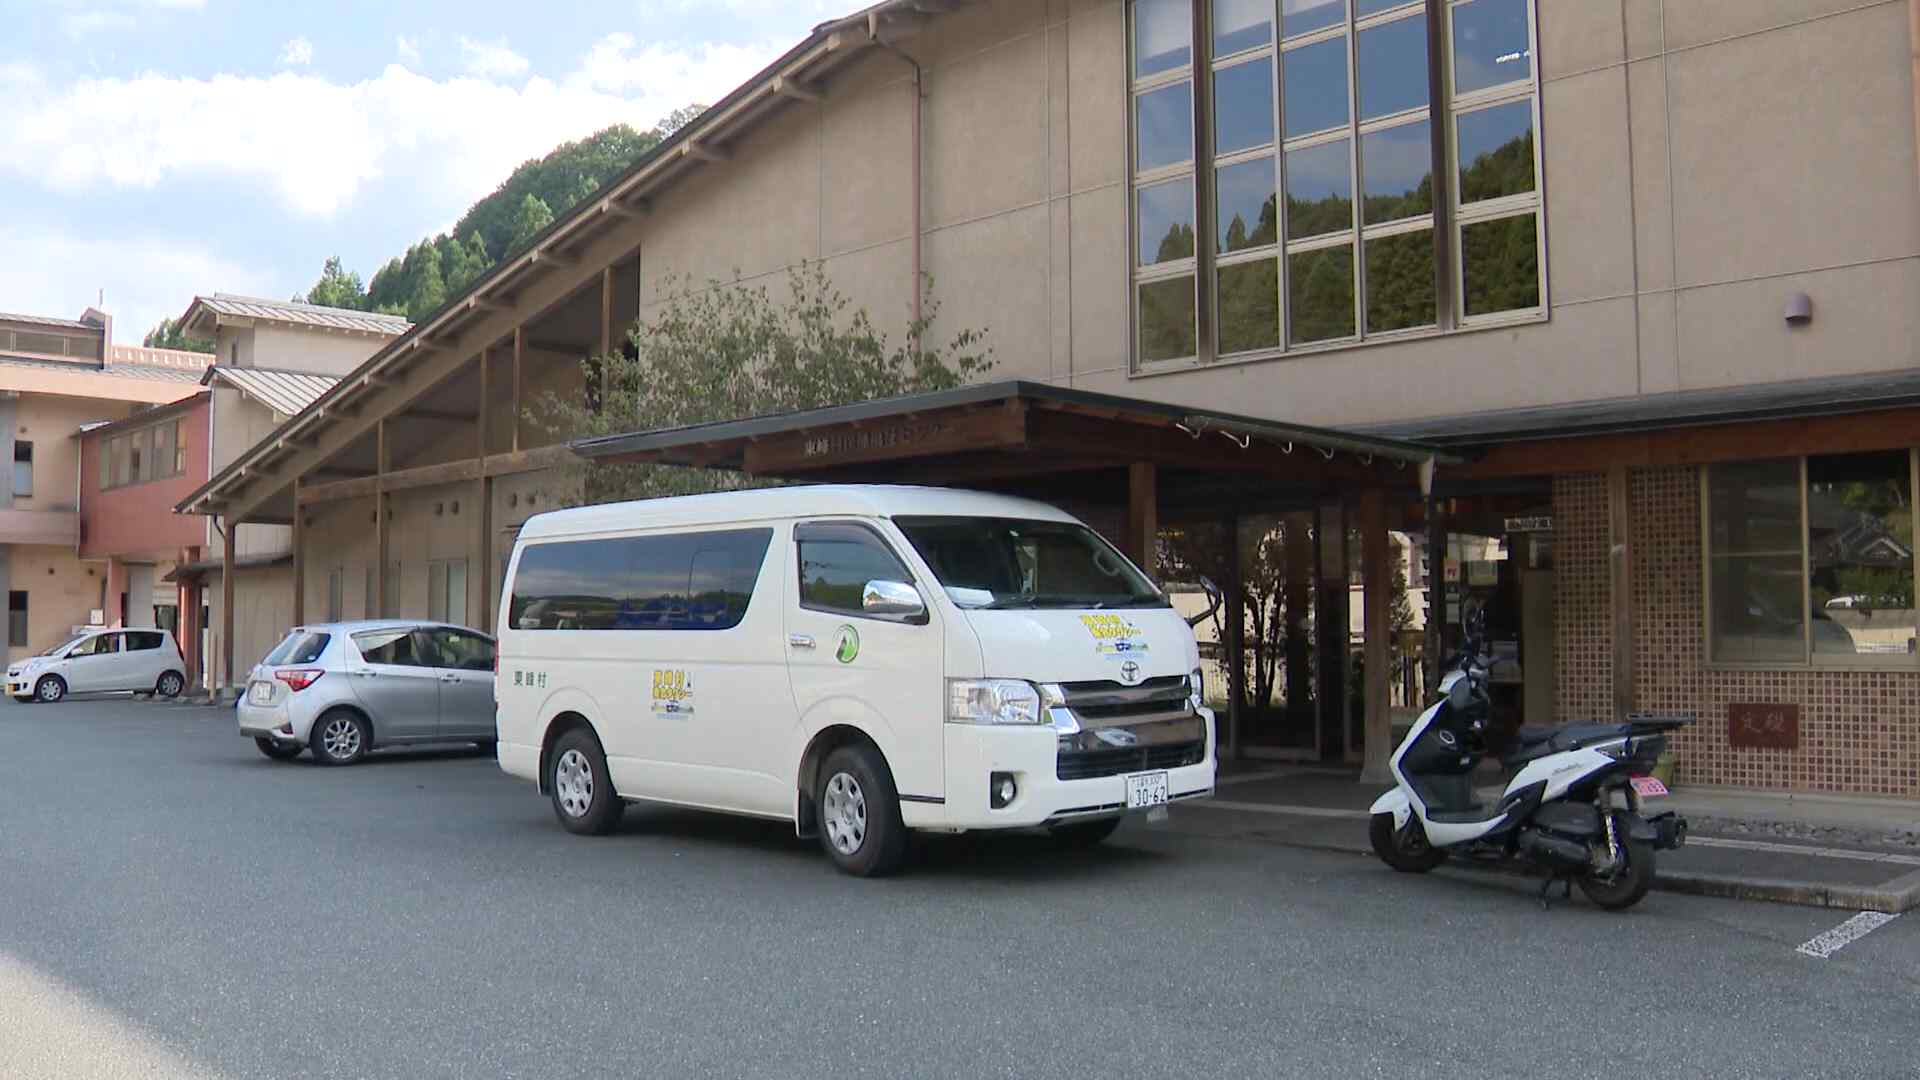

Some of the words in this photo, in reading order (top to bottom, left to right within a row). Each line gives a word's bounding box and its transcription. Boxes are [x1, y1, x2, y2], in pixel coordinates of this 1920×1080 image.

[513, 671, 546, 688] 東峰村
[1135, 786, 1166, 806] 30-62
